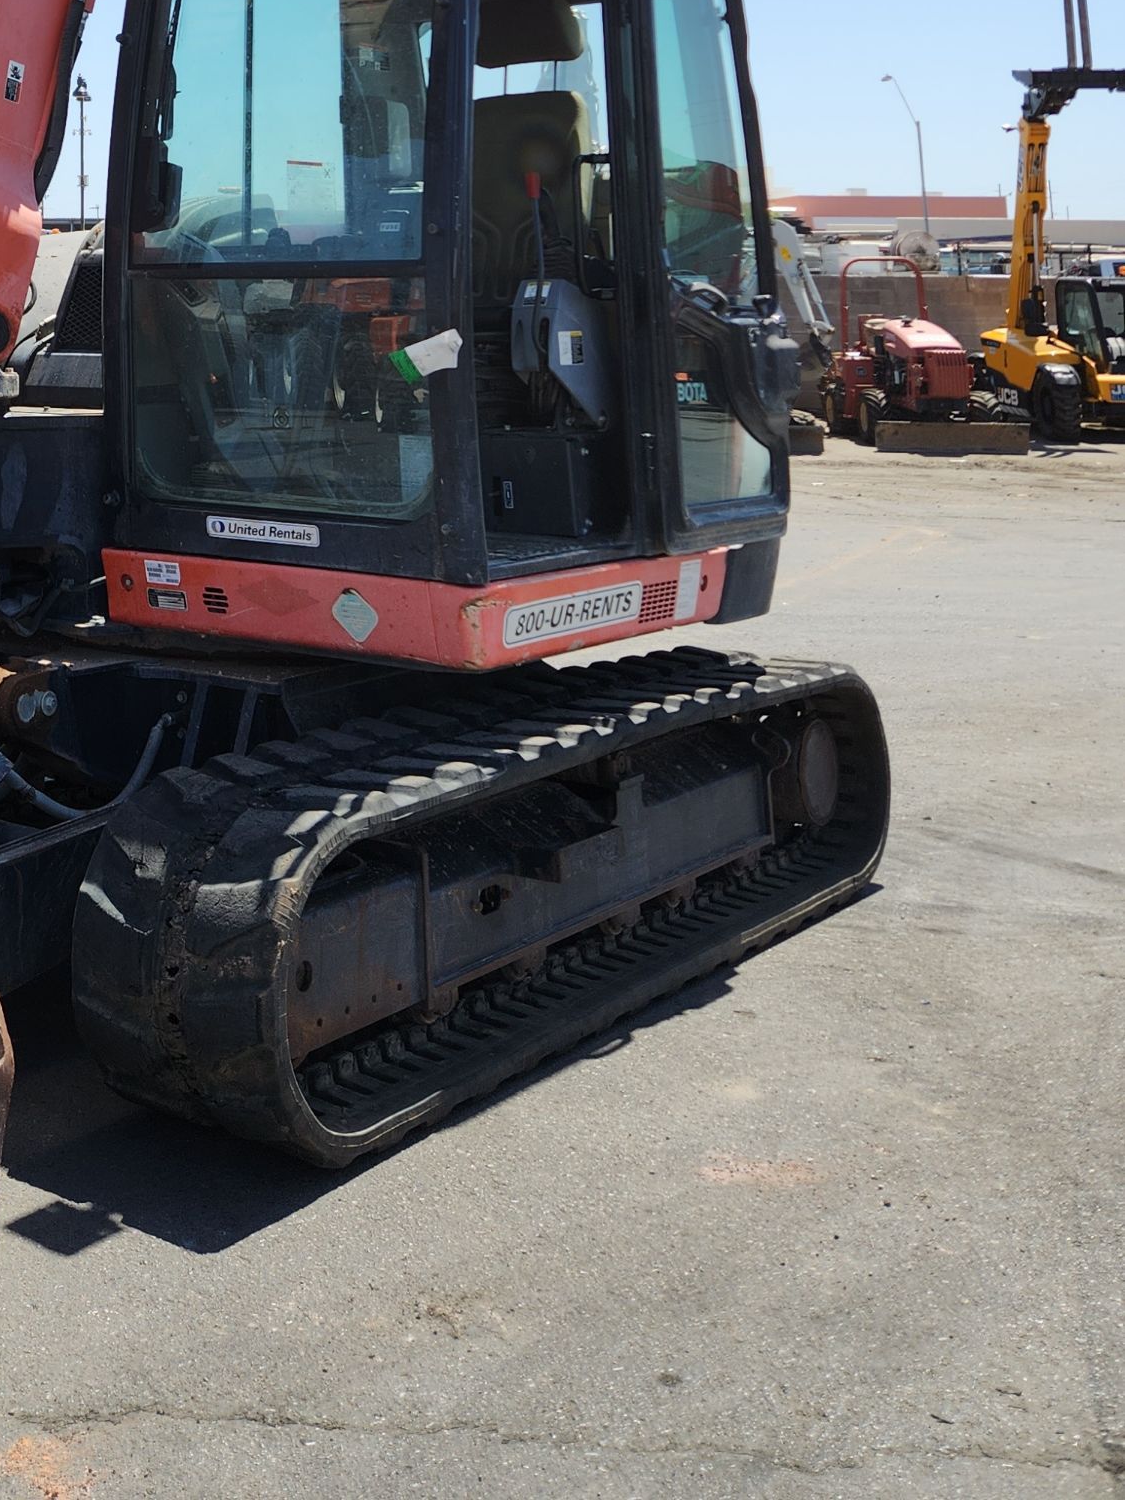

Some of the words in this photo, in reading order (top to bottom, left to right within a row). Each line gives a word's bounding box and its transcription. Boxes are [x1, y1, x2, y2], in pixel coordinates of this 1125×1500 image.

[676, 382, 708, 402] BOTA
[997, 387, 1019, 406] JCB
[228, 522, 266, 537] United
[269, 526, 312, 541] Rentals
[515, 590, 633, 636] 800-UR-RENTS
